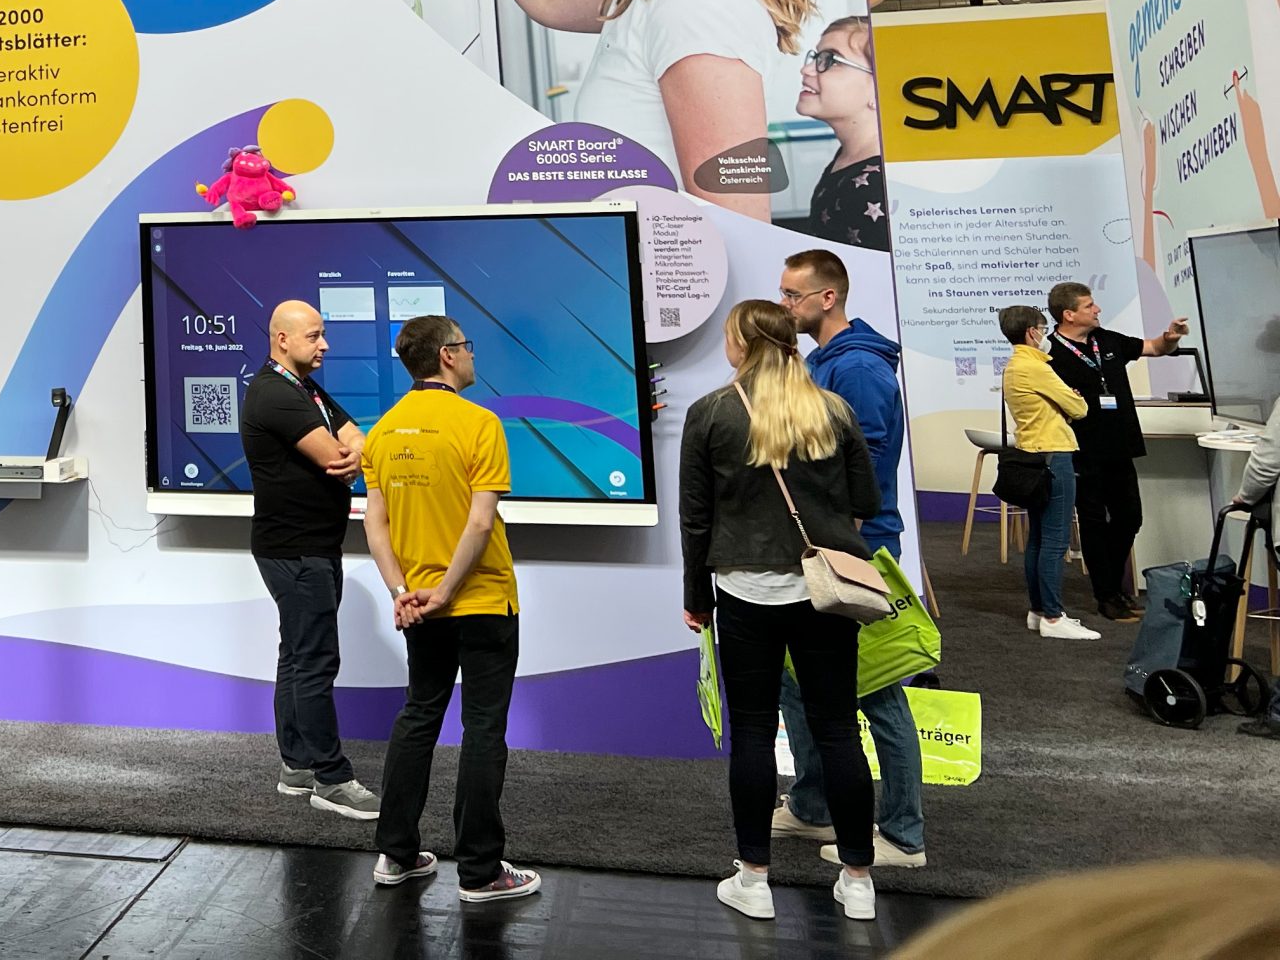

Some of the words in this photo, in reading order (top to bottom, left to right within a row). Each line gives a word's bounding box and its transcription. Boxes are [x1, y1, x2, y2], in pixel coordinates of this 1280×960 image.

[1159, 19, 1205, 88] SCHREIBEN
[902, 73, 1115, 130] SMART
[1159, 89, 1197, 145] WISCHEN
[528, 140, 575, 152] SMART
[1177, 112, 1238, 183] VERSCHIEBEN
[536, 152, 577, 164] 6000S
[580, 152, 617, 163] Serie:
[717, 155, 767, 164] Volksschule
[508, 172, 530, 181] DAS
[532, 171, 565, 181] BESTE
[566, 170, 605, 180] SEINER
[607, 169, 648, 179] KLASSE
[718, 165, 772, 175] Gunskirchen
[719, 175, 763, 184] Österreich
[909, 207, 977, 218] Spielerisches
[980, 206, 1016, 215] Lernen
[1019, 205, 1053, 215] spricht
[899, 222, 951, 231] Menschen
[954, 221, 963, 230] in
[965, 220, 992, 231] jeder
[995, 219, 1048, 228] Altersstufe
[898, 235, 918, 244] Das
[921, 234, 953, 243] merke
[955, 234, 970, 242] ich
[972, 233, 981, 242] in
[985, 233, 1023, 241] meinen
[1025, 232, 1071, 241] Stunden.
[894, 249, 911, 257] Die
[913, 247, 978, 257] Schülerinnen
[982, 246, 1001, 255] und
[1004, 246, 1042, 255] Schüler
[1045, 245, 1079, 254] haben
[896, 262, 922, 271] mehr
[925, 262, 955, 272] Spaß,
[957, 261, 978, 270] sind
[981, 260, 1039, 270] motivierter
[1042, 260, 1062, 268] und
[1065, 259, 1080, 268] ich
[906, 275, 930, 284] kann
[933, 275, 946, 284] sie
[949, 274, 975, 283] doch
[977, 274, 1010, 283] immer
[1014, 273, 1034, 282] mal
[1037, 273, 1072, 282] wieder
[687, 292, 710, 300] Log-in
[928, 289, 943, 298] ins
[945, 289, 989, 298] Staunen
[922, 306, 986, 314] Sekundarlehrer
[182, 315, 236, 335] 10:51
[960, 318, 996, 327] Schulen,
[919, 728, 972, 746] träger
